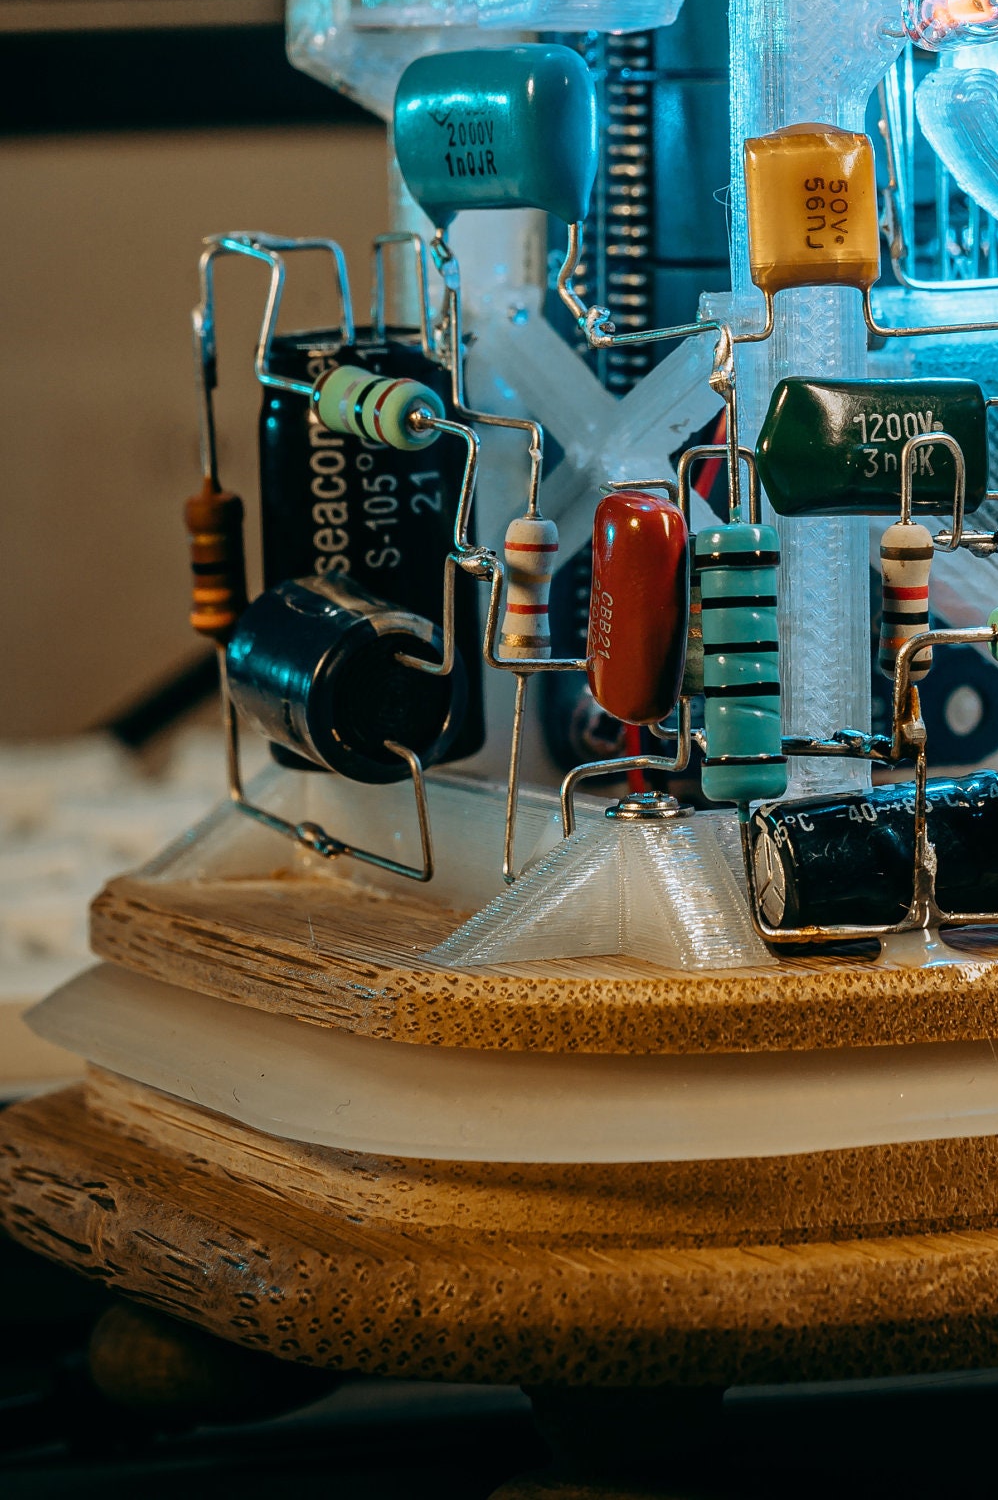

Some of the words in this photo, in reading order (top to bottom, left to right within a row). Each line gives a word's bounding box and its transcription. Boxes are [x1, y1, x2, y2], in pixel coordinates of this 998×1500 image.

[447, 121, 494, 147] 2000V
[804, 177, 826, 249] 56nJ
[410, 470, 442, 514] 21
[598, 591, 614, 660] CBB21
